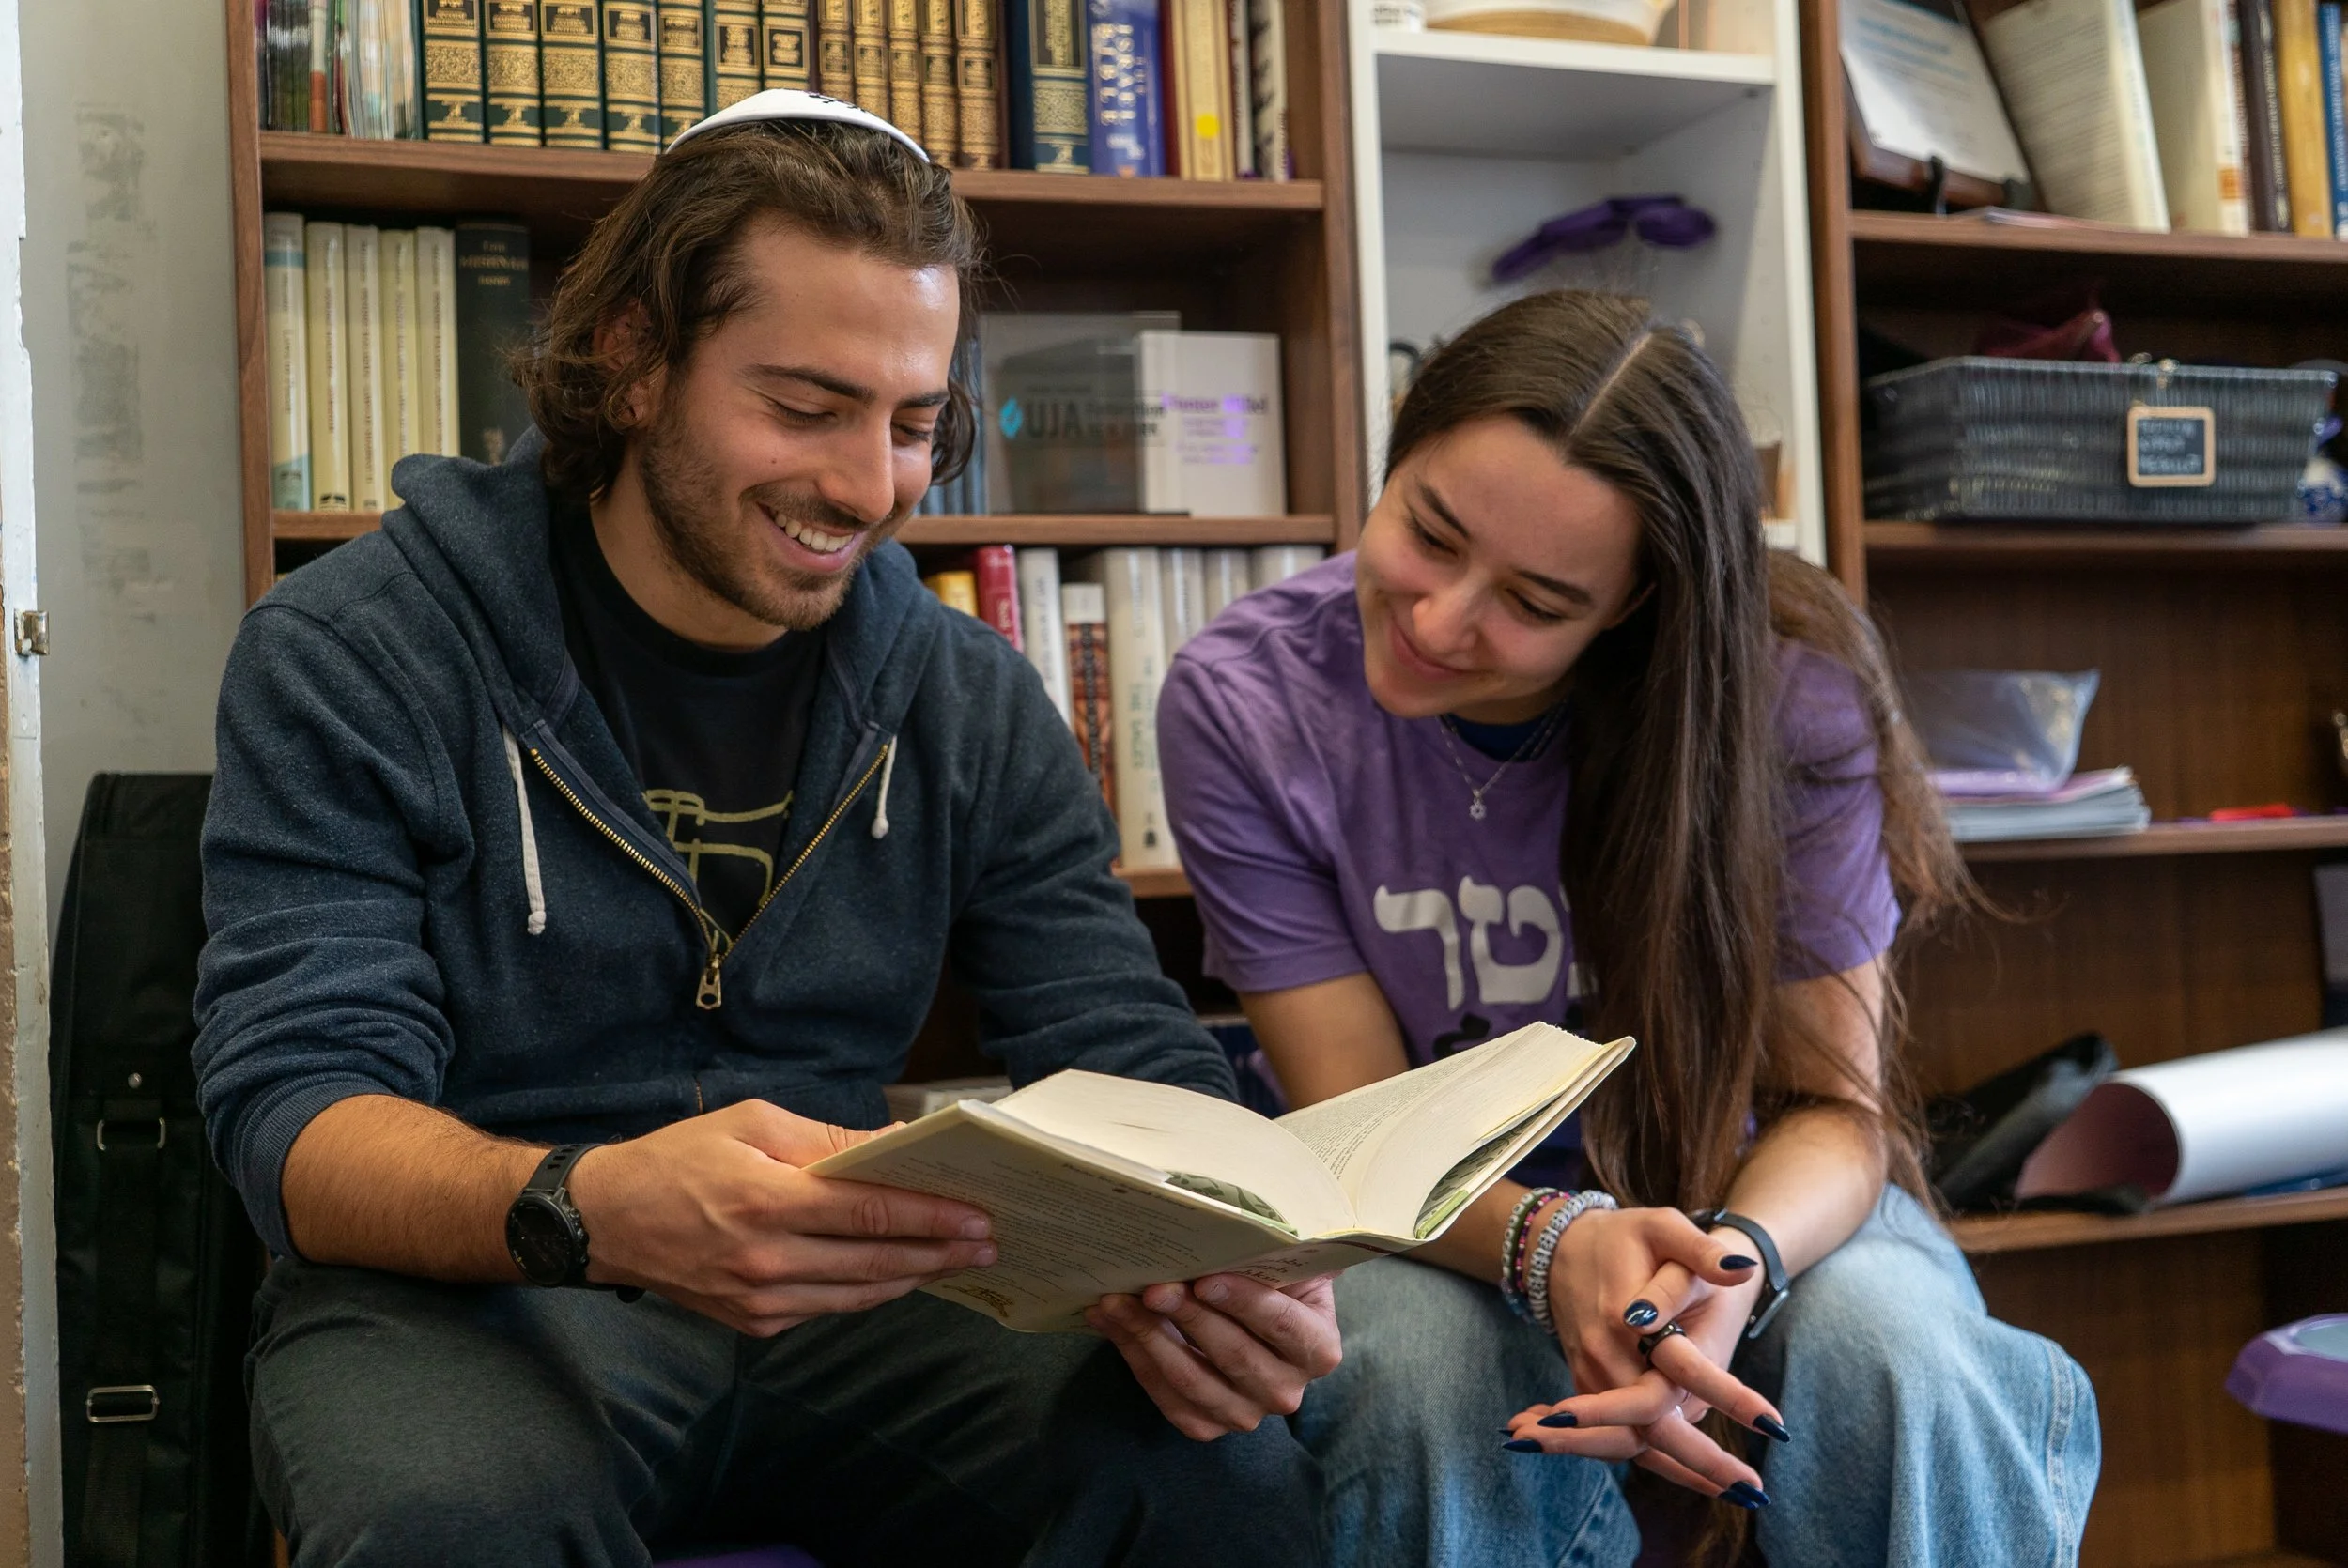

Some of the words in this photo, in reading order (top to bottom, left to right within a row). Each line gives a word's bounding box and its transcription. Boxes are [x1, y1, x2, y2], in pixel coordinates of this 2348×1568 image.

[1096, 23, 1120, 126] BIBLE
[1115, 23, 1136, 126] ISRAEL
[1027, 399, 1083, 438] UJA
[1373, 875, 1597, 1012] טר
